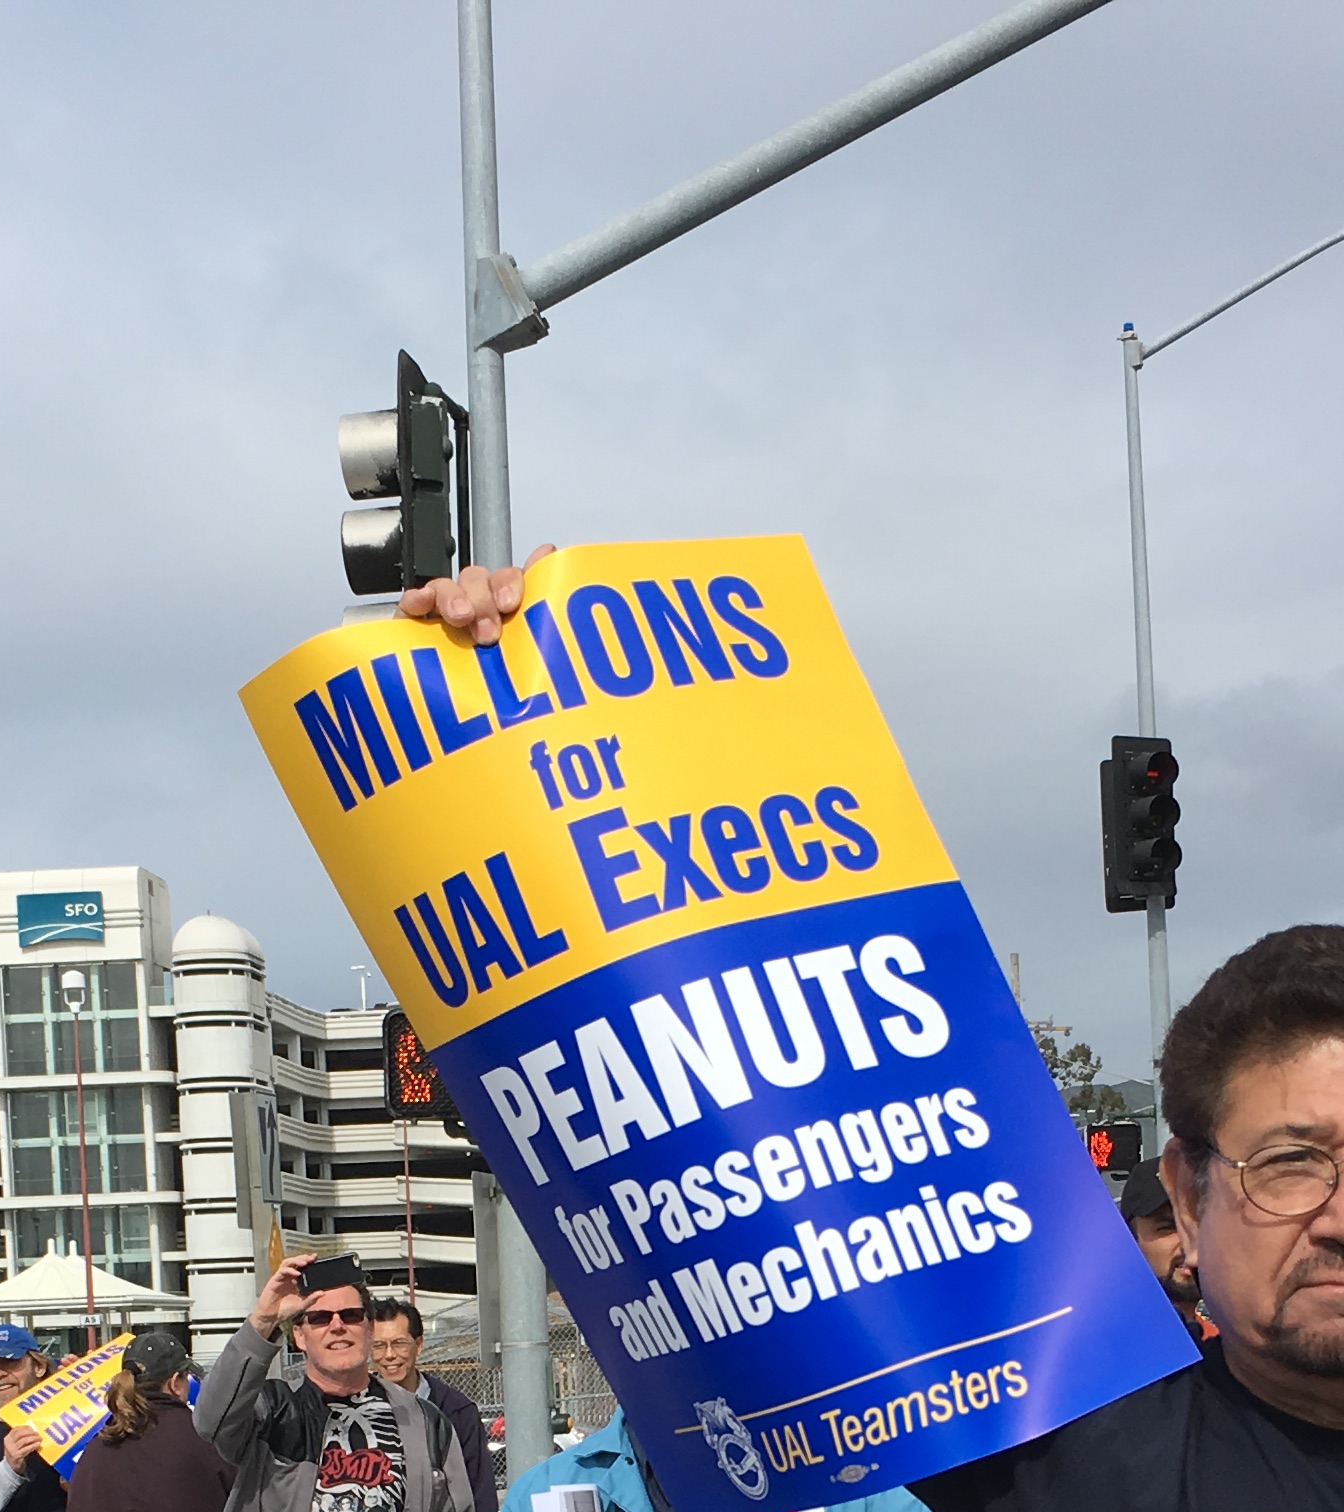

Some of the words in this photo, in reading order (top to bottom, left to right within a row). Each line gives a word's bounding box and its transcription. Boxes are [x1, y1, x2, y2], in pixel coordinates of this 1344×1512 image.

[293, 575, 790, 812] MILLIONS
[530, 735, 627, 810] for
[64, 903, 98, 917] SFO
[394, 852, 570, 1008] UAL
[567, 785, 881, 933] Execs
[480, 933, 951, 1187] PEANUTS
[555, 1203, 624, 1275] for
[609, 1087, 991, 1255] Passengers
[609, 1279, 691, 1363] and
[671, 1179, 1033, 1343] Mechanics
[17, 1344, 127, 1416] MILLIONS
[44, 1404, 94, 1446] UAL
[73, 1378, 95, 1394] for
[760, 1421, 825, 1473] UAL
[819, 1357, 1029, 1458] Teamsters
